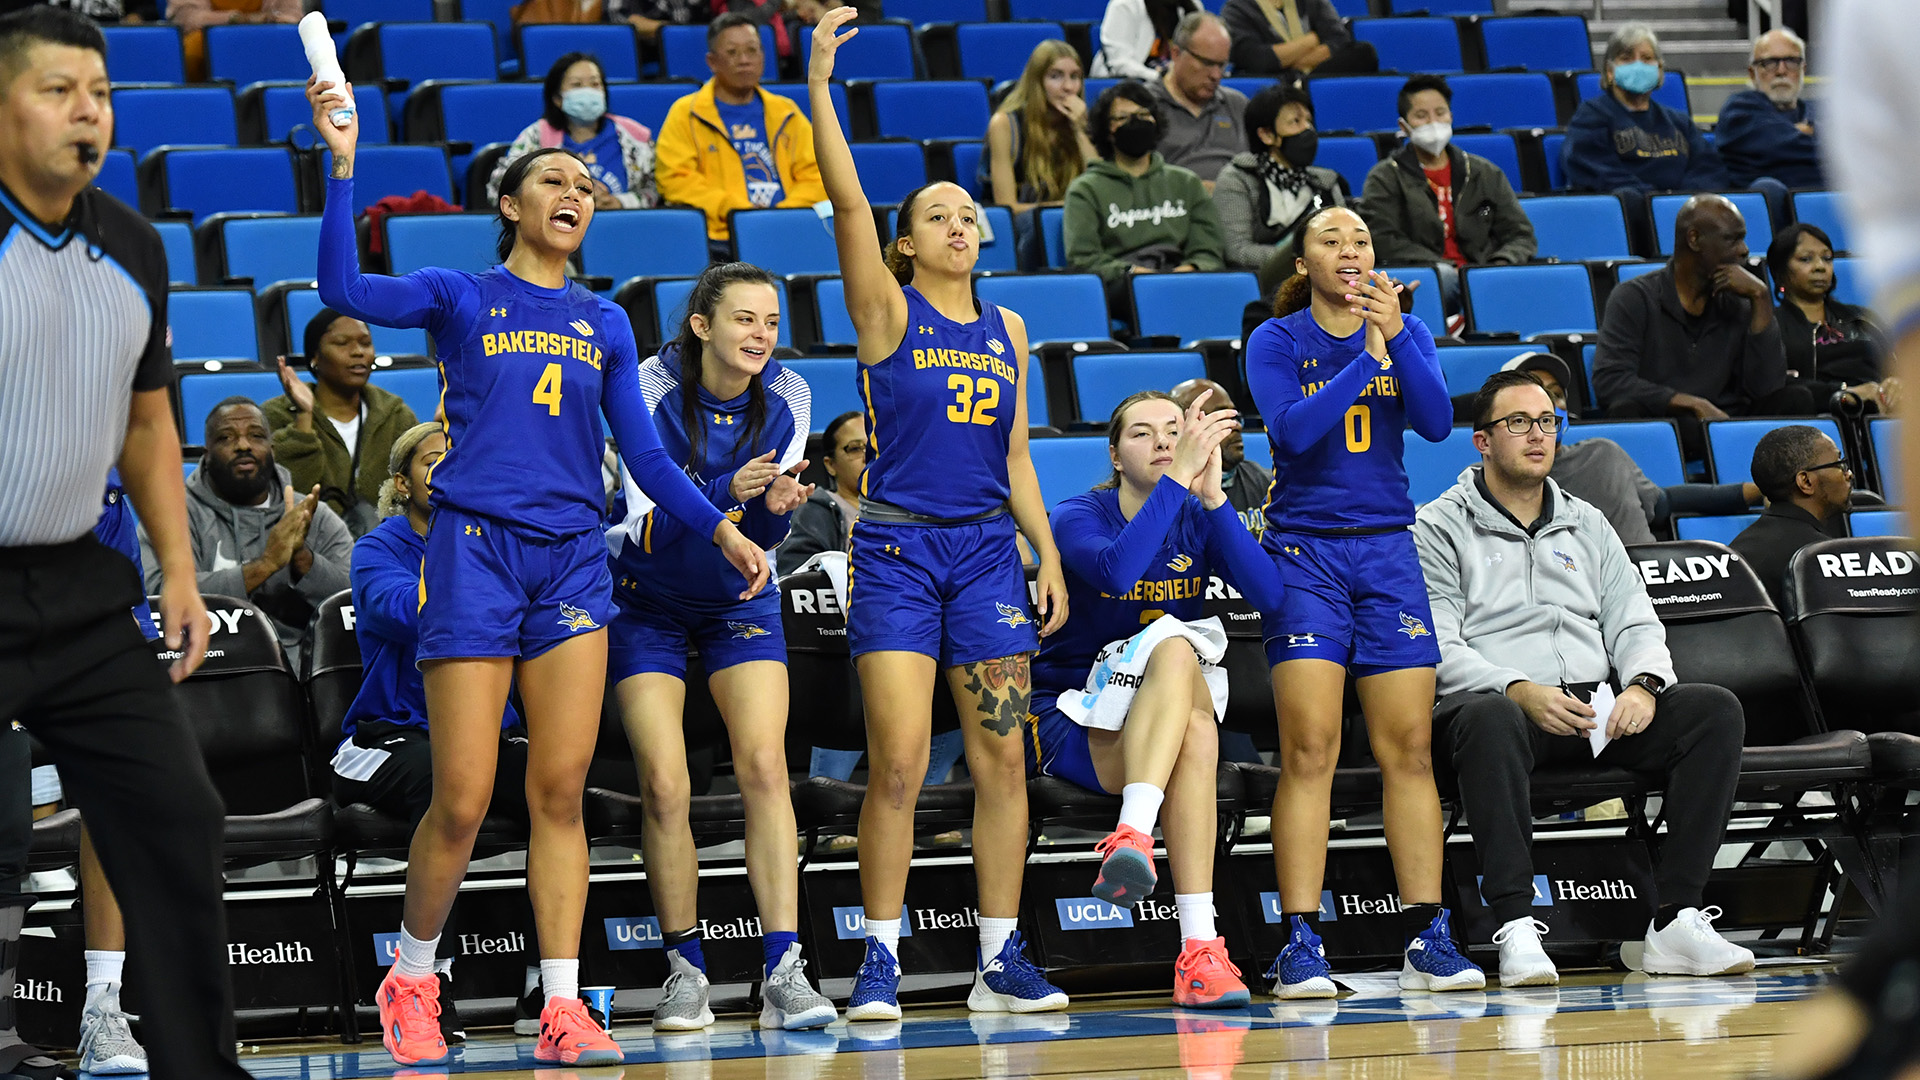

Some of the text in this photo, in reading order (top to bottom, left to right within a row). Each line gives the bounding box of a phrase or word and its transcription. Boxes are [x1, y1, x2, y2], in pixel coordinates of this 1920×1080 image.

[482, 330, 603, 371] BAKERSFIELD
[912, 348, 1016, 386] BAKERSFIELD
[532, 362, 563, 417] 4
[947, 373, 1001, 427] 32
[1344, 404, 1372, 454] 0
[1554, 879, 1638, 901] Health
[1067, 903, 1124, 923] UCLA
[1339, 893, 1403, 916] Healt
[914, 906, 981, 931] Healt
[458, 931, 526, 956] Healt
[615, 923, 664, 943] UCL
[226, 940, 315, 966] Health
[12, 978, 64, 1003] alth
